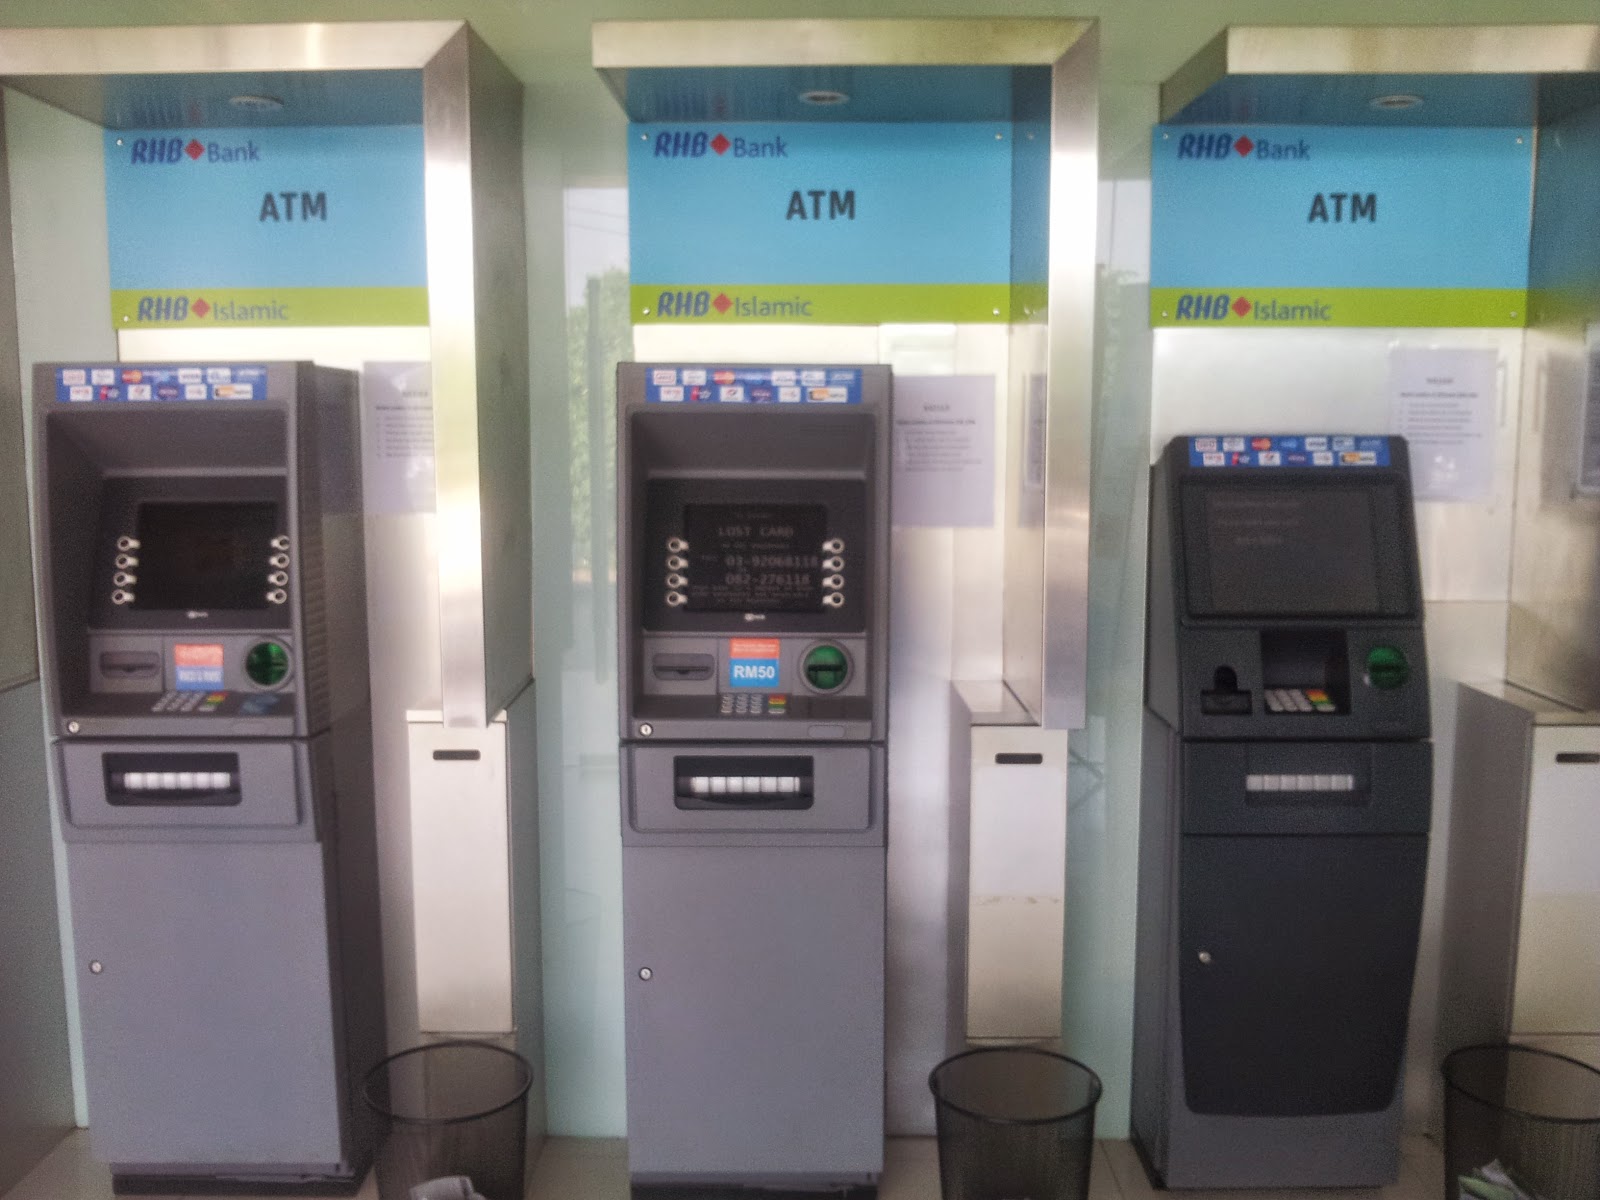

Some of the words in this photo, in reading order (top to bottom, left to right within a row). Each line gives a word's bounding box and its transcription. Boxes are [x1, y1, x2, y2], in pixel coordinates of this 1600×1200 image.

[131, 137, 184, 164] RHB
[206, 140, 260, 163] Bank
[654, 131, 709, 158] RHB
[733, 136, 788, 159] Bank
[1177, 133, 1233, 160] RHB
[1256, 138, 1311, 161] Bank
[259, 191, 328, 222] ATM
[786, 190, 856, 220] ATM
[1308, 193, 1377, 223] ATM
[137, 296, 189, 322] RHB
[213, 300, 289, 322] Islamic
[656, 291, 710, 317] RHB
[735, 296, 813, 317] Islamic
[1175, 294, 1230, 320] RHB
[1253, 299, 1331, 321] Islamic
[733, 665, 775, 678] RM50
